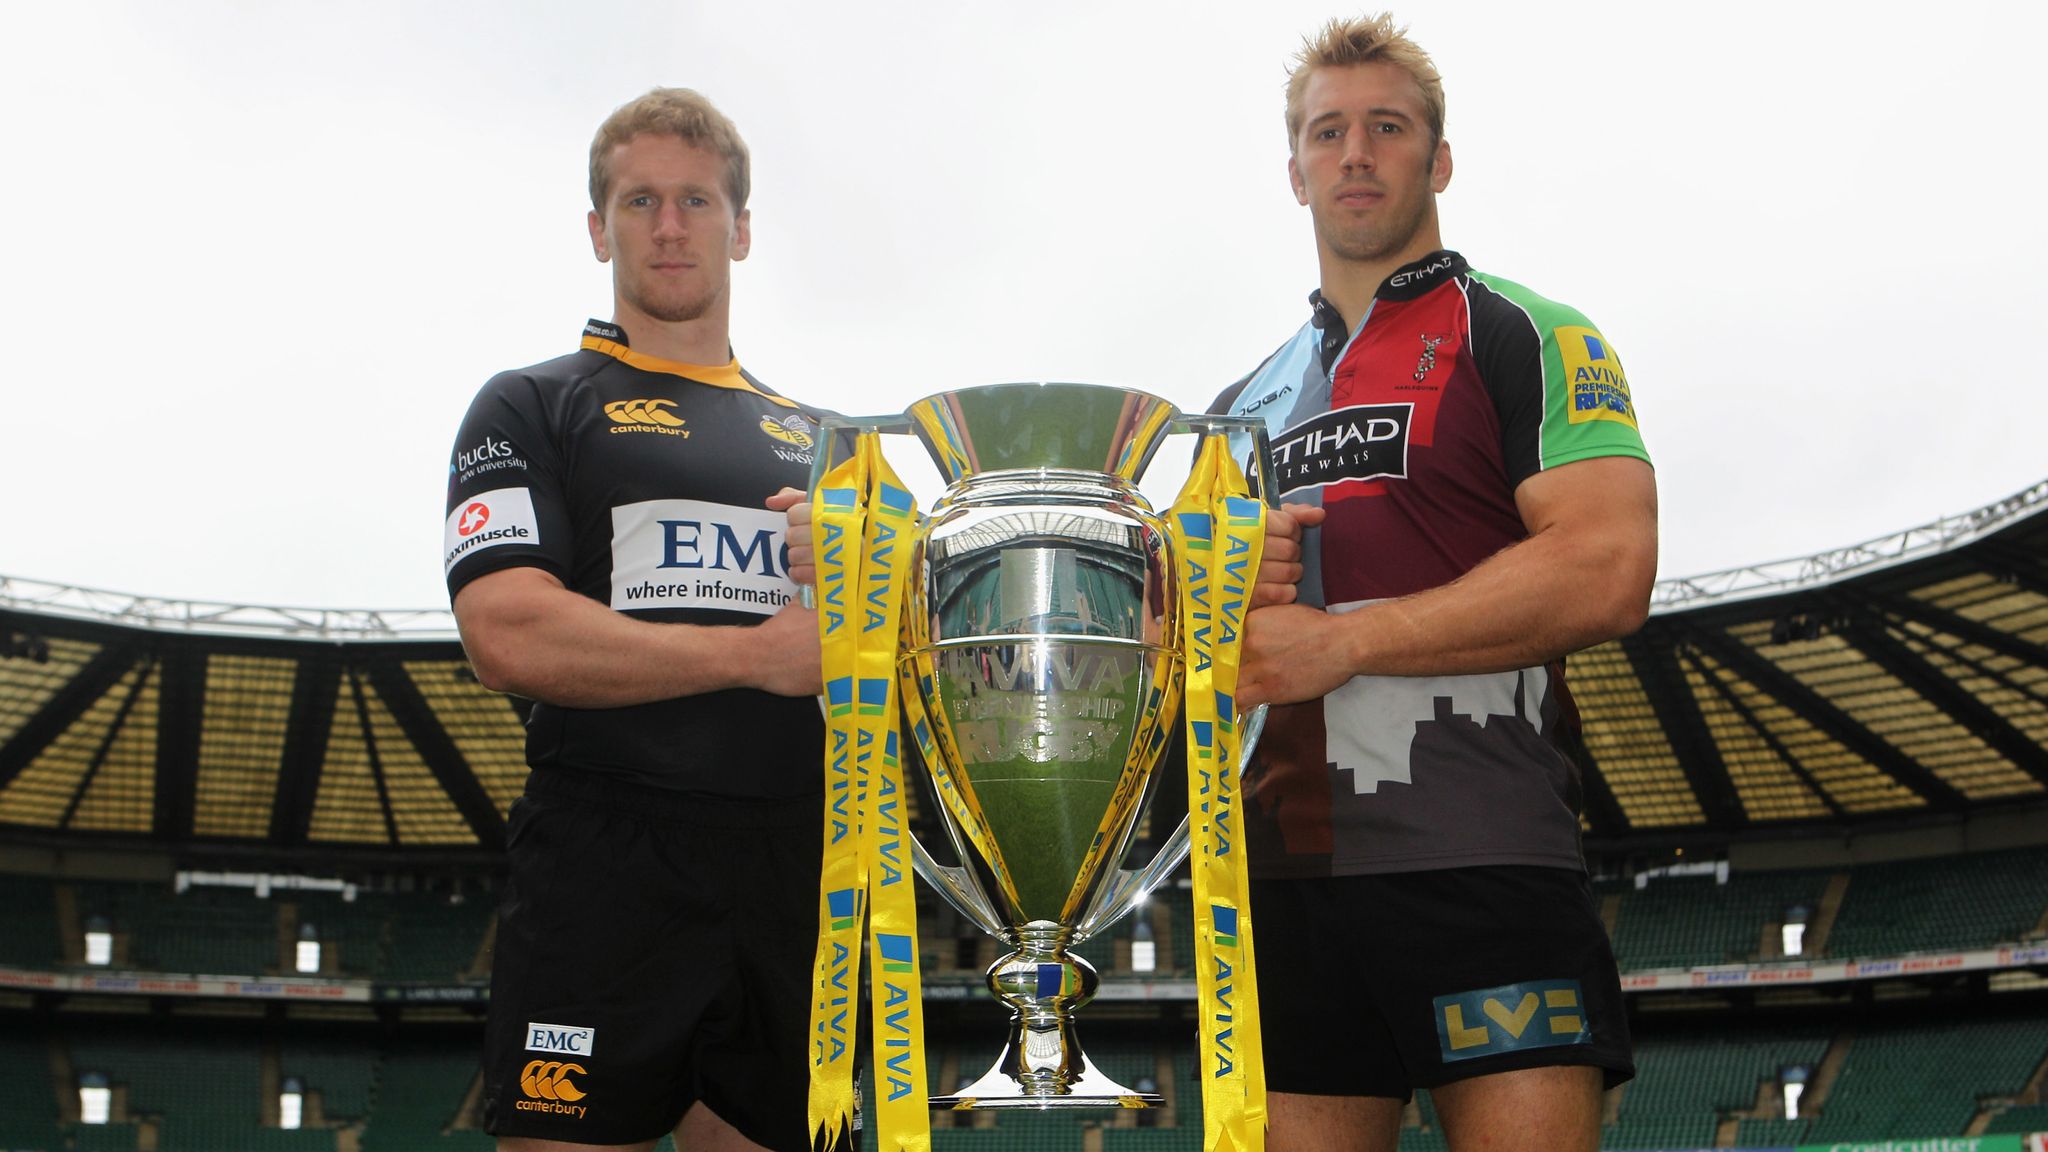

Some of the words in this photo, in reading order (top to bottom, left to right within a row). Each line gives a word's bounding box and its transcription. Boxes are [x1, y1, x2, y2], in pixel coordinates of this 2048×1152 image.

[610, 425, 690, 439] canterbury
[1575, 366, 1625, 389] AVIVA
[458, 436, 512, 471] bucks
[460, 468, 475, 483] new
[477, 457, 527, 475] university
[774, 450, 814, 465] WASP
[1287, 451, 1369, 478] IRWAYS
[626, 581, 688, 599] where
[696, 580, 791, 606] informatio
[656, 520, 790, 579] EM
[821, 522, 845, 635] AVIVA
[863, 521, 896, 633] AVIVA
[1218, 534, 1250, 644] AVIVA
[1186, 559, 1212, 673] AVIVA
[831, 729, 849, 845] AVIVA
[878, 773, 903, 887] AVIVA
[1215, 739, 1231, 857] AVIVA
[829, 942, 849, 1064] AVIVA
[884, 981, 912, 1102] AVIVA
[1214, 955, 1232, 1078] AVIVA
[516, 1100, 586, 1119] canterbury
